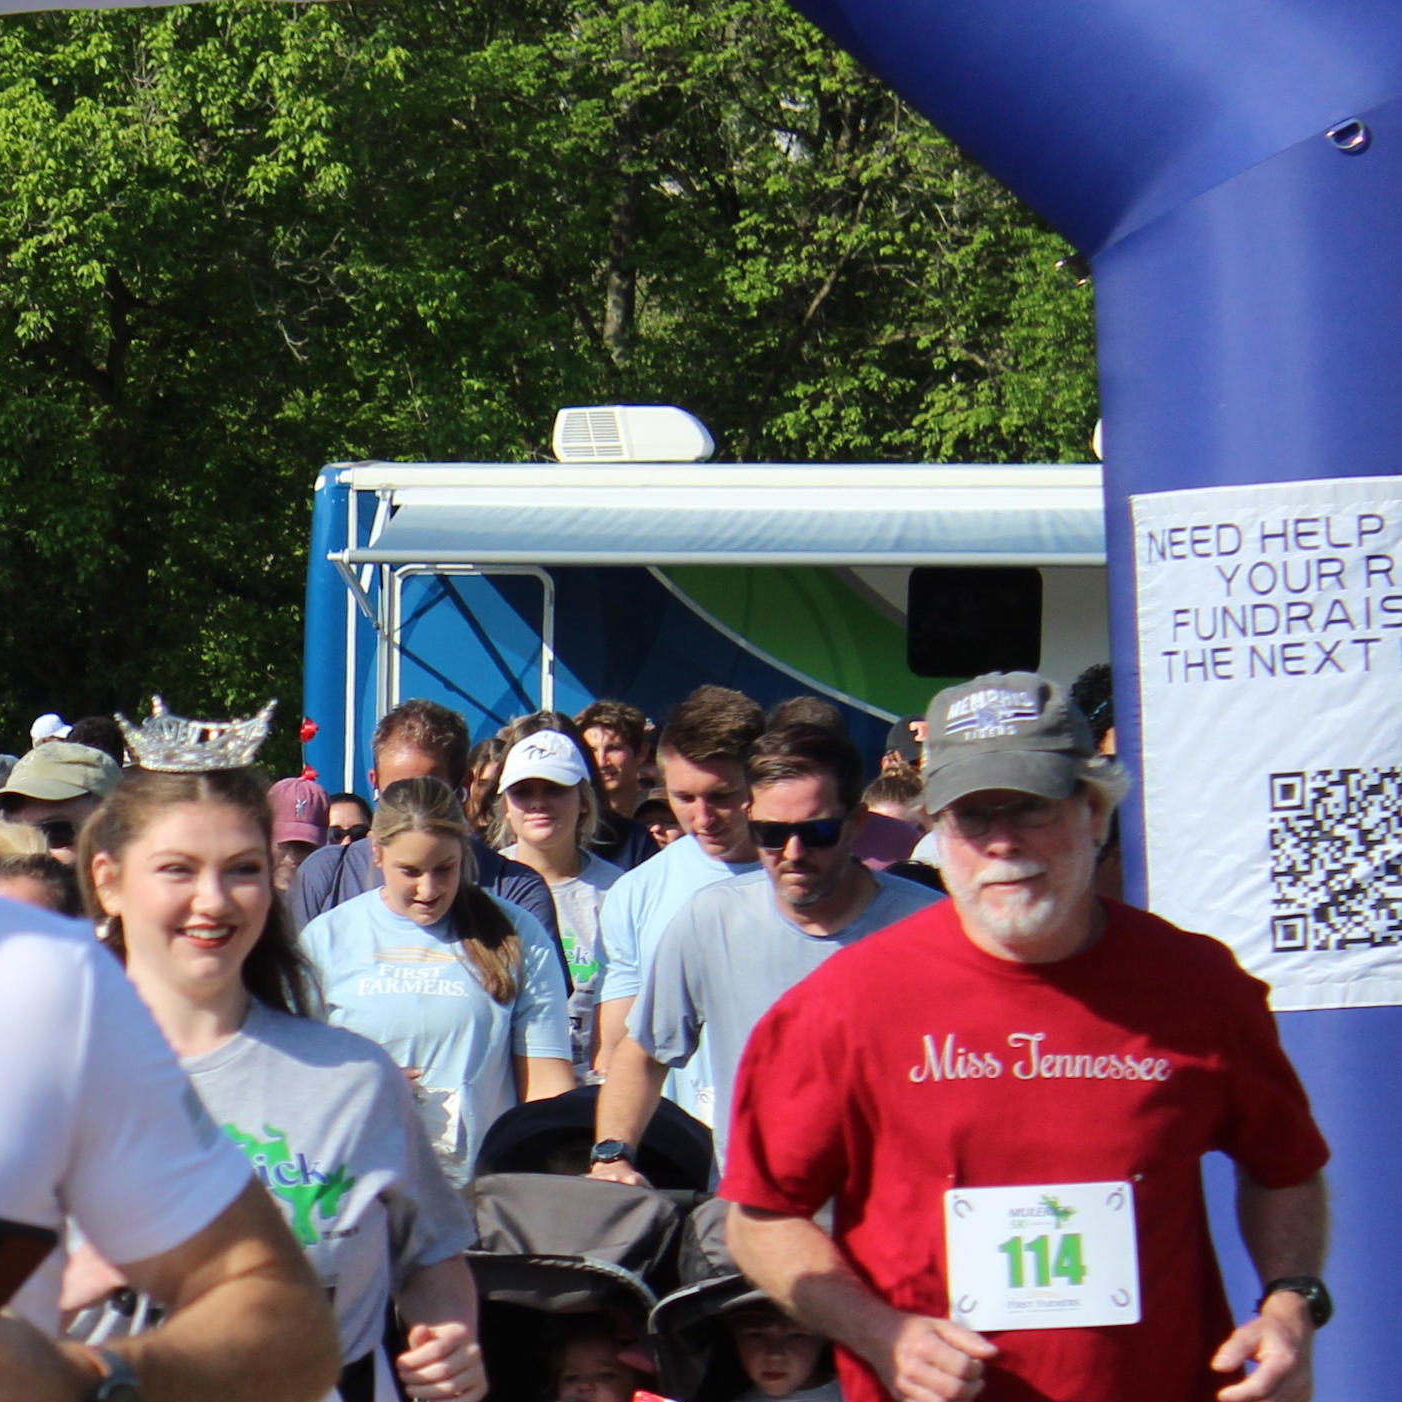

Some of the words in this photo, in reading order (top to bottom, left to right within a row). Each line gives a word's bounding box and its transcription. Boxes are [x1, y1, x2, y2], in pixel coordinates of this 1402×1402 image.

[1147, 523, 1242, 563] NEED
[1260, 513, 1385, 554] HELP
[1216, 557, 1345, 597] YOUR
[1172, 594, 1402, 642] FUNDRAIS
[1162, 647, 1234, 683] THE
[1249, 637, 1382, 680] NEXT
[946, 688, 1035, 721] MEMPHIS
[377, 962, 442, 980] FIRST
[908, 1033, 1002, 1084] Miss
[1007, 1032, 1171, 1082] Tennessee
[998, 1232, 1087, 1289] 114
